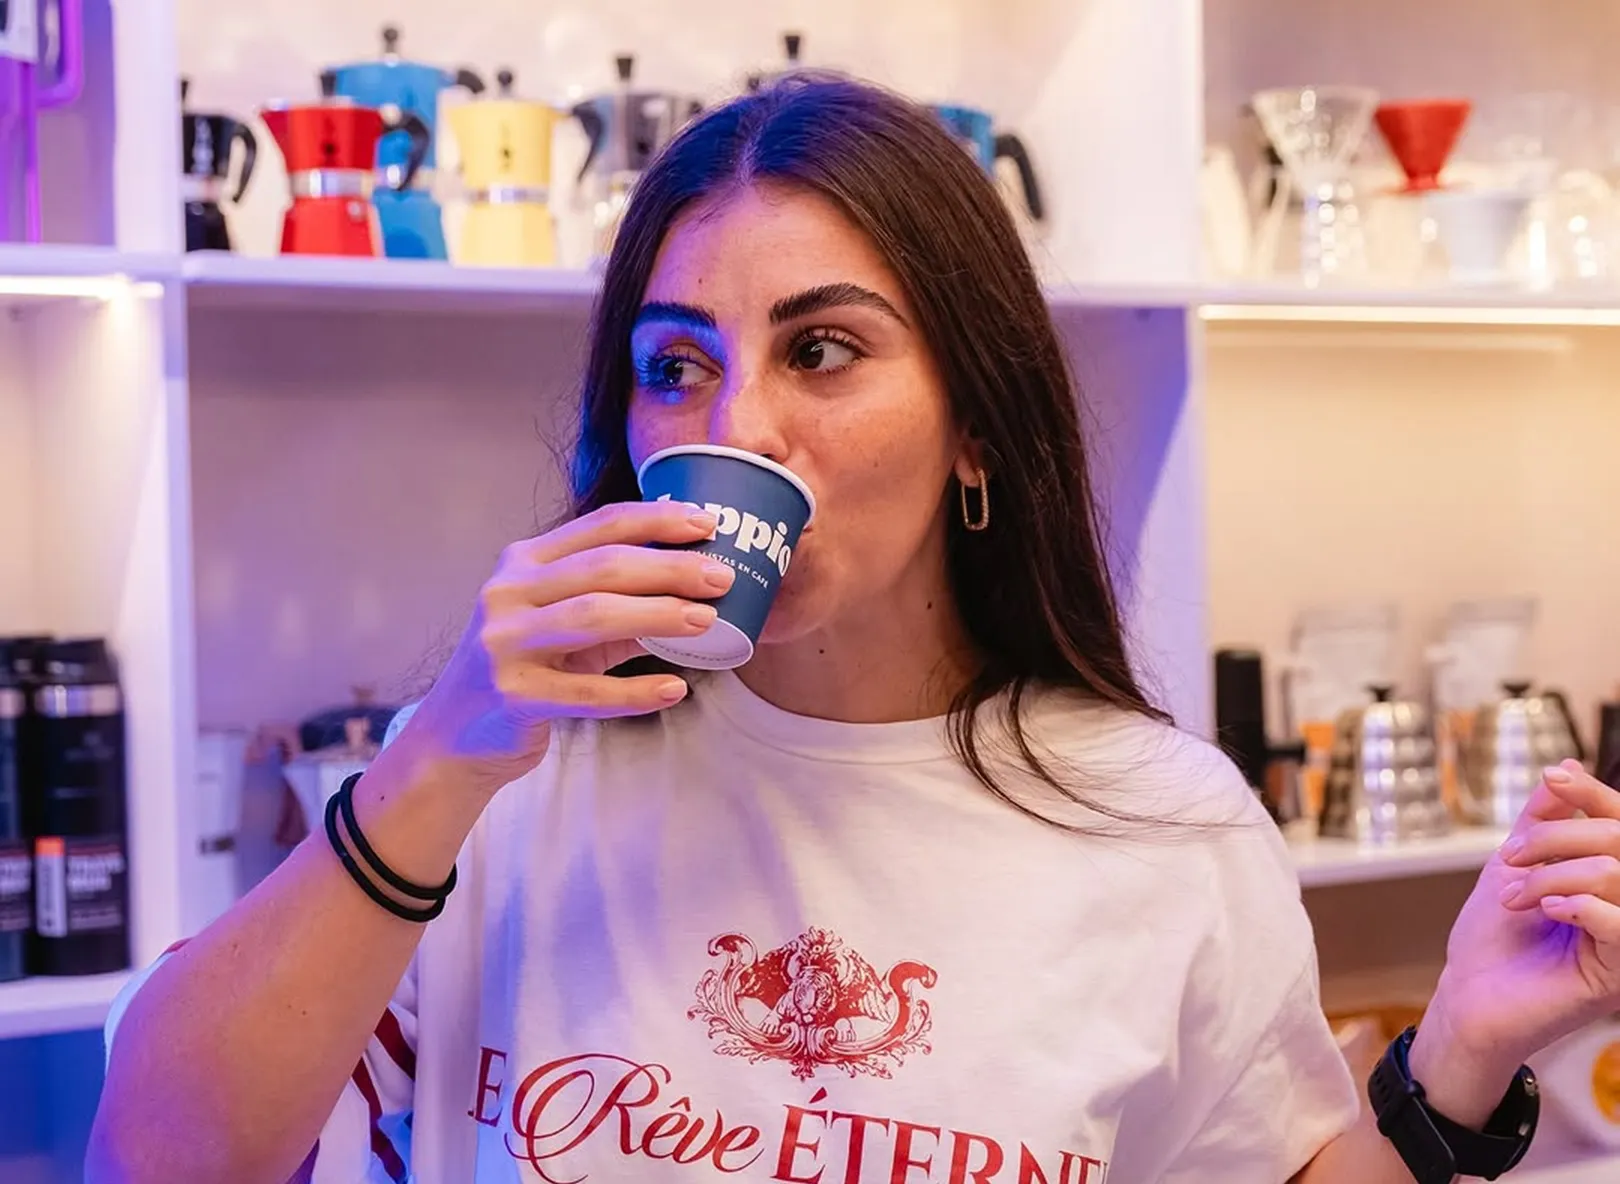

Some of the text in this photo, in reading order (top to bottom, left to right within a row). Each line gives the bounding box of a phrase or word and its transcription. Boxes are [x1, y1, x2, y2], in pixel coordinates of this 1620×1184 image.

[657, 494, 792, 577] ppio
[738, 562, 751, 574] EN
[467, 1046, 507, 1127] E
[504, 1053, 764, 1184] Rêve
